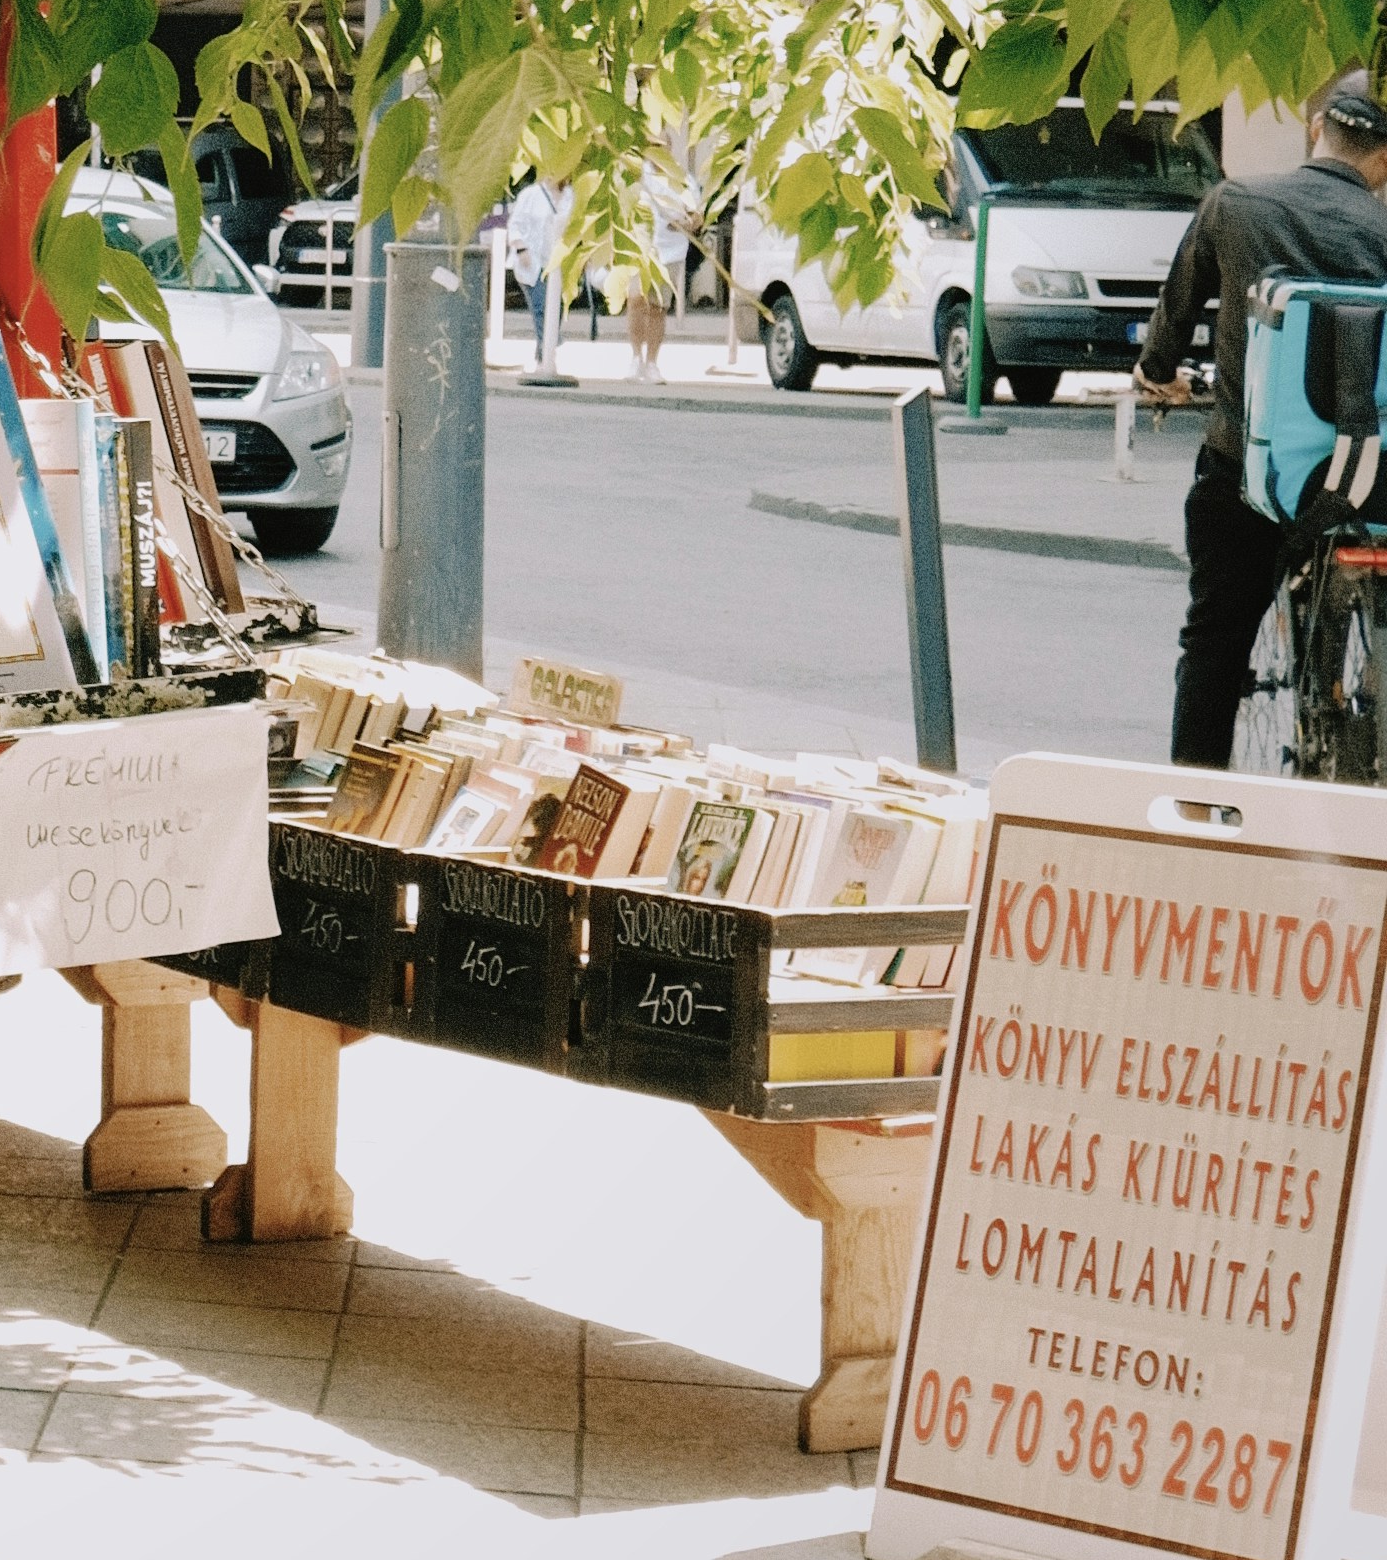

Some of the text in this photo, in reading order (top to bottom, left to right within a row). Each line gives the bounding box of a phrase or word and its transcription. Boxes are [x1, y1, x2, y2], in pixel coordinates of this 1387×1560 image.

[133, 480, 158, 588] MUSZÁJ?!
[574, 776, 621, 822] NELSON
[63, 869, 205, 945] 900,-
[989, 863, 1377, 1011] KÖNYVMENTŐK
[969, 1003, 1355, 1135] KÖNYV ELSZÁLLÍTÁS
[969, 1114, 1322, 1233] LAKÁS KIÜRÍTÉS
[956, 1212, 1303, 1336] LOMTALANÍTÁS
[1027, 1325, 1207, 1397] TELEFON:
[913, 1368, 1294, 1518] 06 70 363 2287
